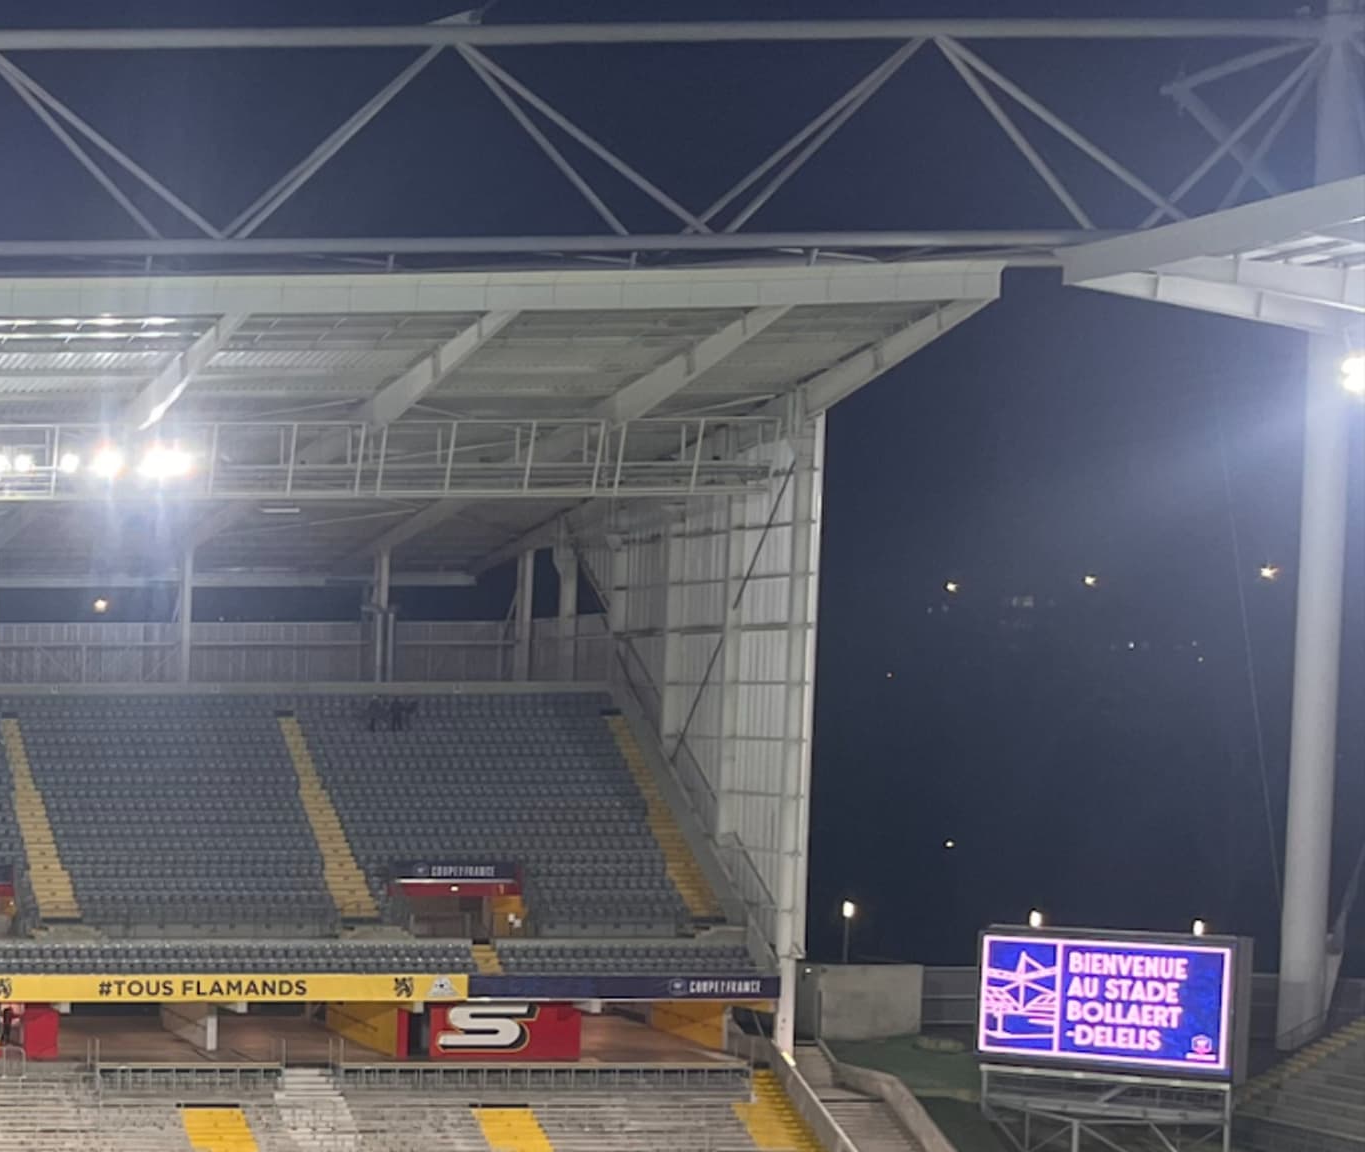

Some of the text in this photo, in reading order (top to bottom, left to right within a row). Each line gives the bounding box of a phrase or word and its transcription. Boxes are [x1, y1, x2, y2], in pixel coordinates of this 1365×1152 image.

[1069, 951, 1188, 980] BIENVENUE
[98, 979, 308, 997] #TOUS FLAMANDS
[1067, 978, 1180, 1004] AU STADE
[437, 1003, 534, 1051] S
[1066, 1003, 1184, 1028] BOLLAERT
[1066, 1027, 1162, 1051] -DELELIS
